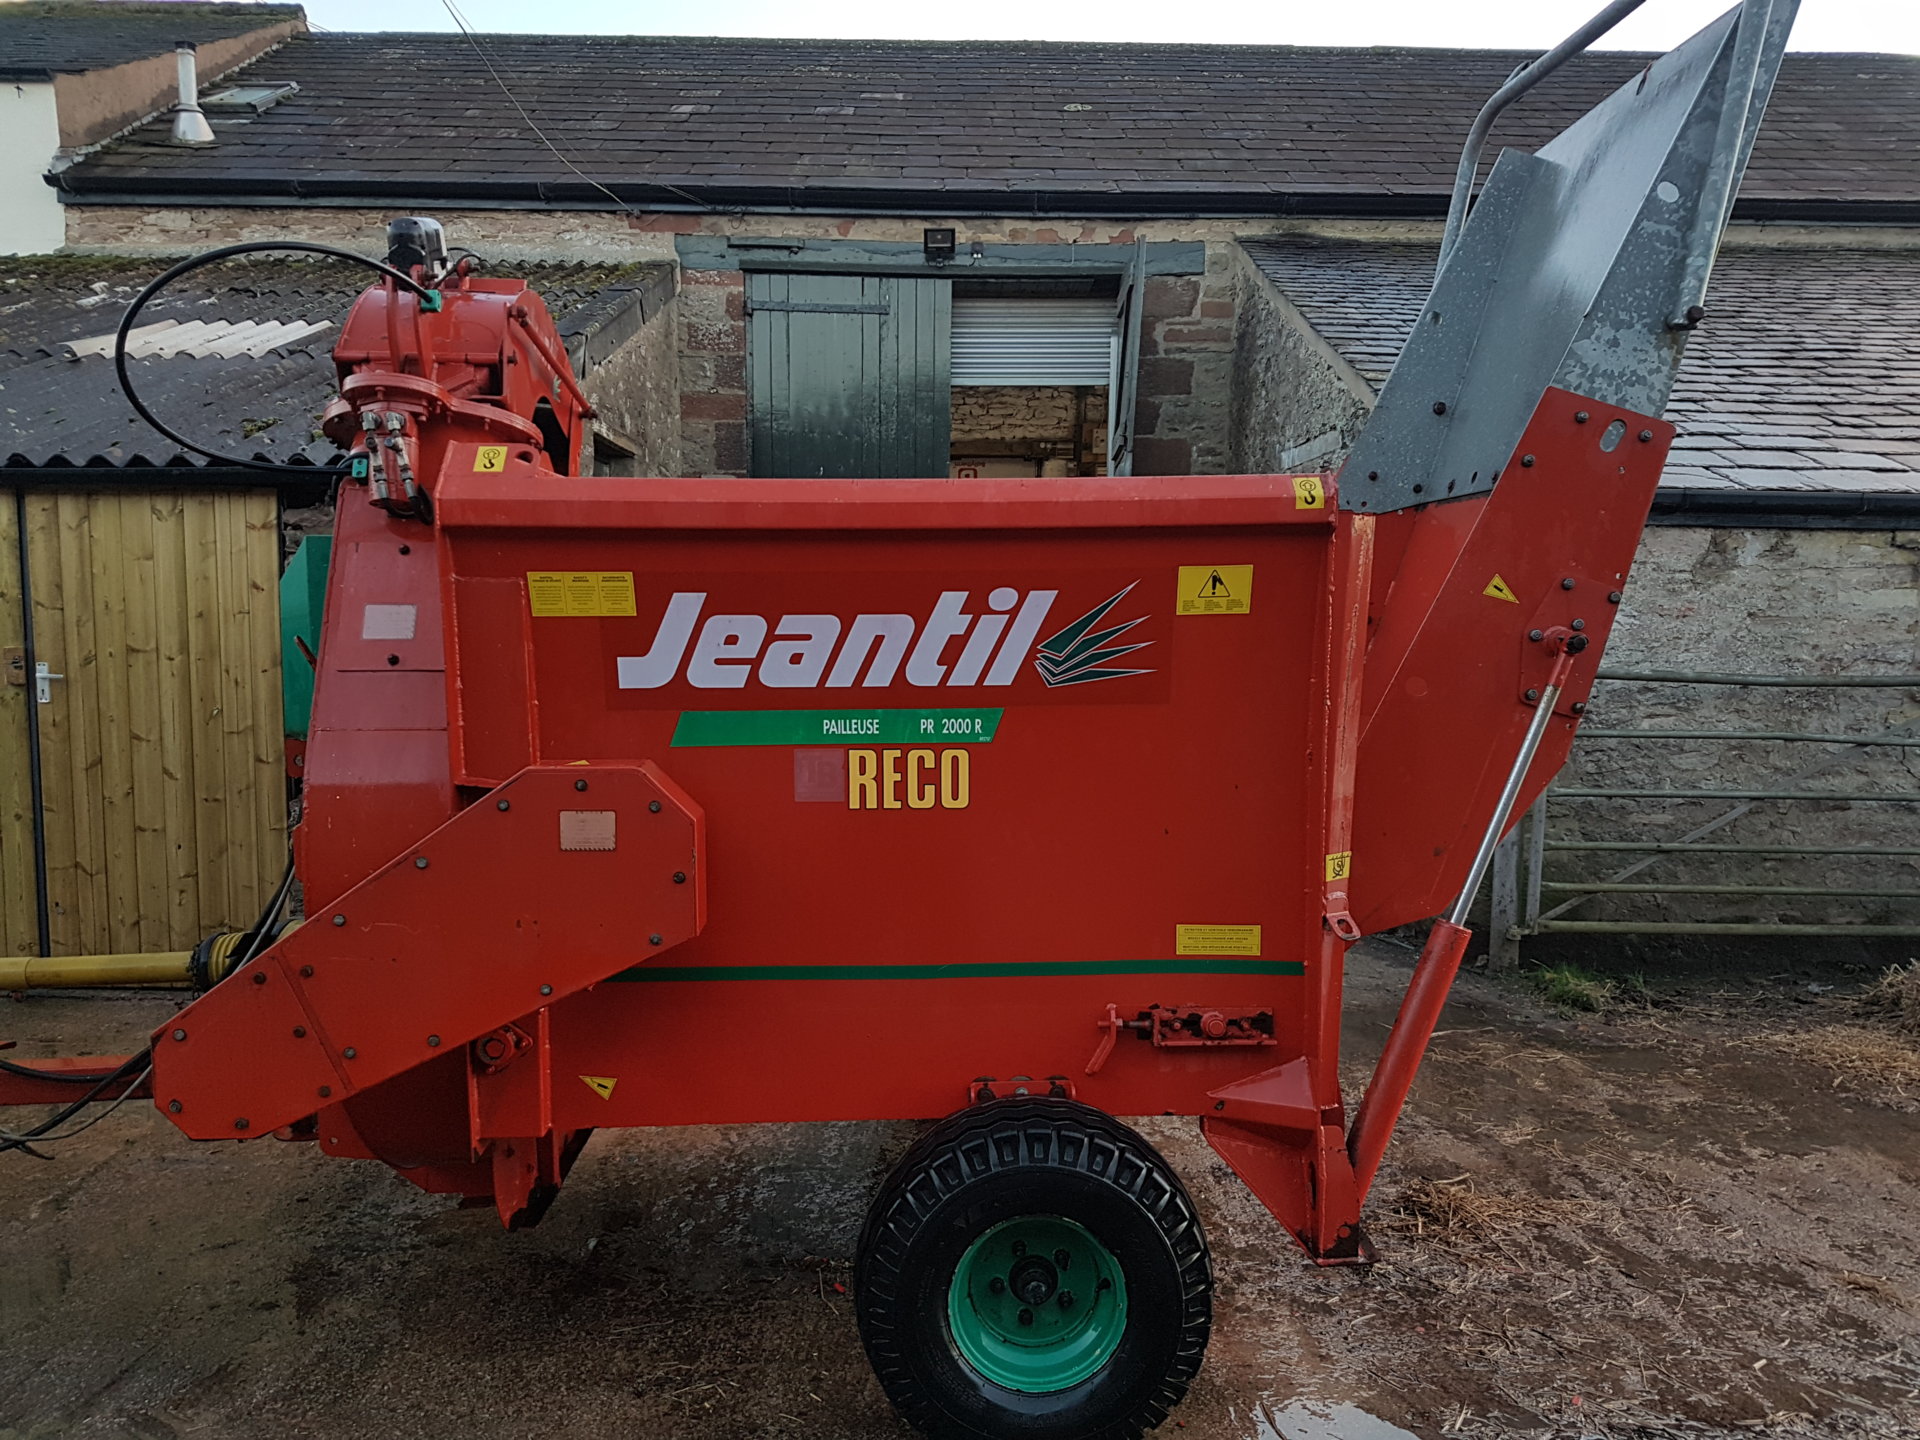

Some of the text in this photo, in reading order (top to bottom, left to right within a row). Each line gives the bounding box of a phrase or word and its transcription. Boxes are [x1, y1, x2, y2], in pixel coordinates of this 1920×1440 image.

[616, 586, 1059, 689] Jeantil
[822, 718, 880, 735] PAILLEUSE
[920, 718, 983, 734] PR 2000 R
[847, 748, 971, 811] RECO
